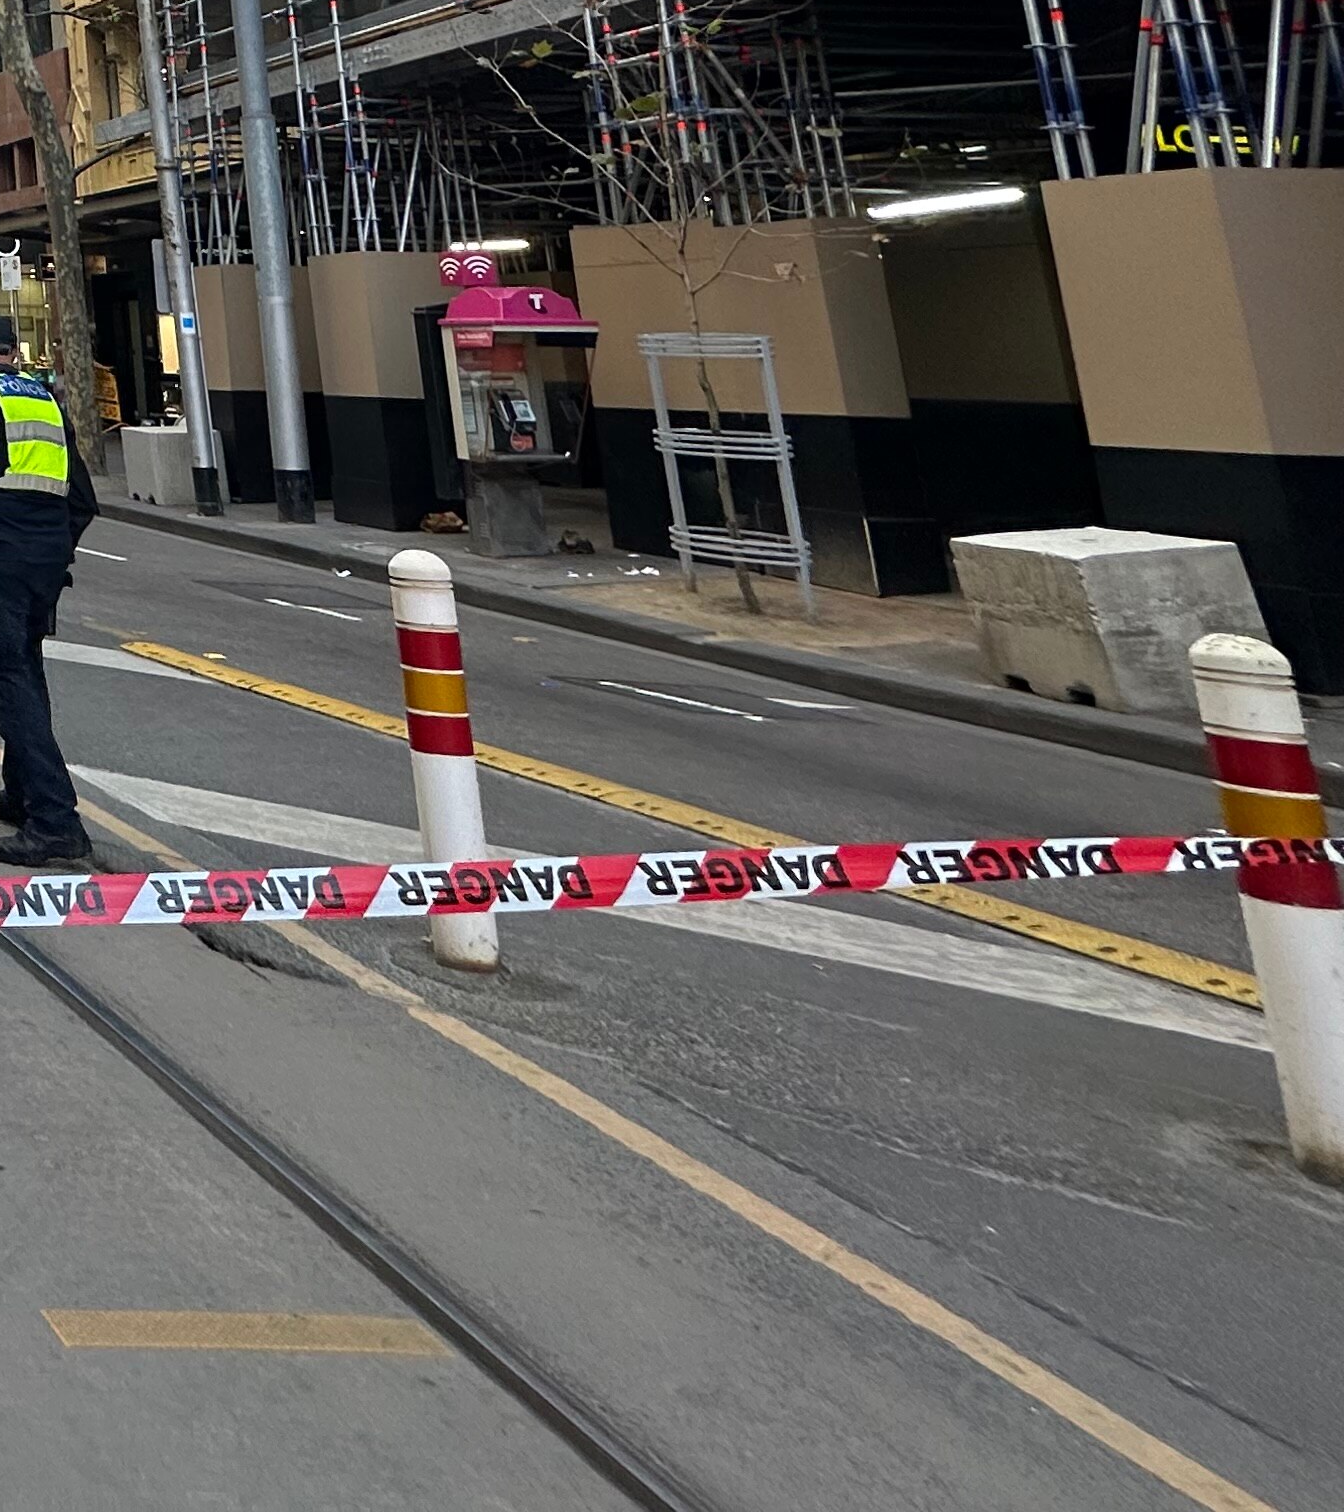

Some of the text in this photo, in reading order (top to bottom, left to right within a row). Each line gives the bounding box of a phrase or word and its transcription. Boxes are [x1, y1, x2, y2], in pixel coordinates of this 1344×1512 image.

[529, 293, 543, 310] T
[150, 873, 346, 914] DANGER
[385, 863, 594, 906] DANGER
[637, 852, 852, 896] DANGER
[896, 843, 1121, 885] DANGER
